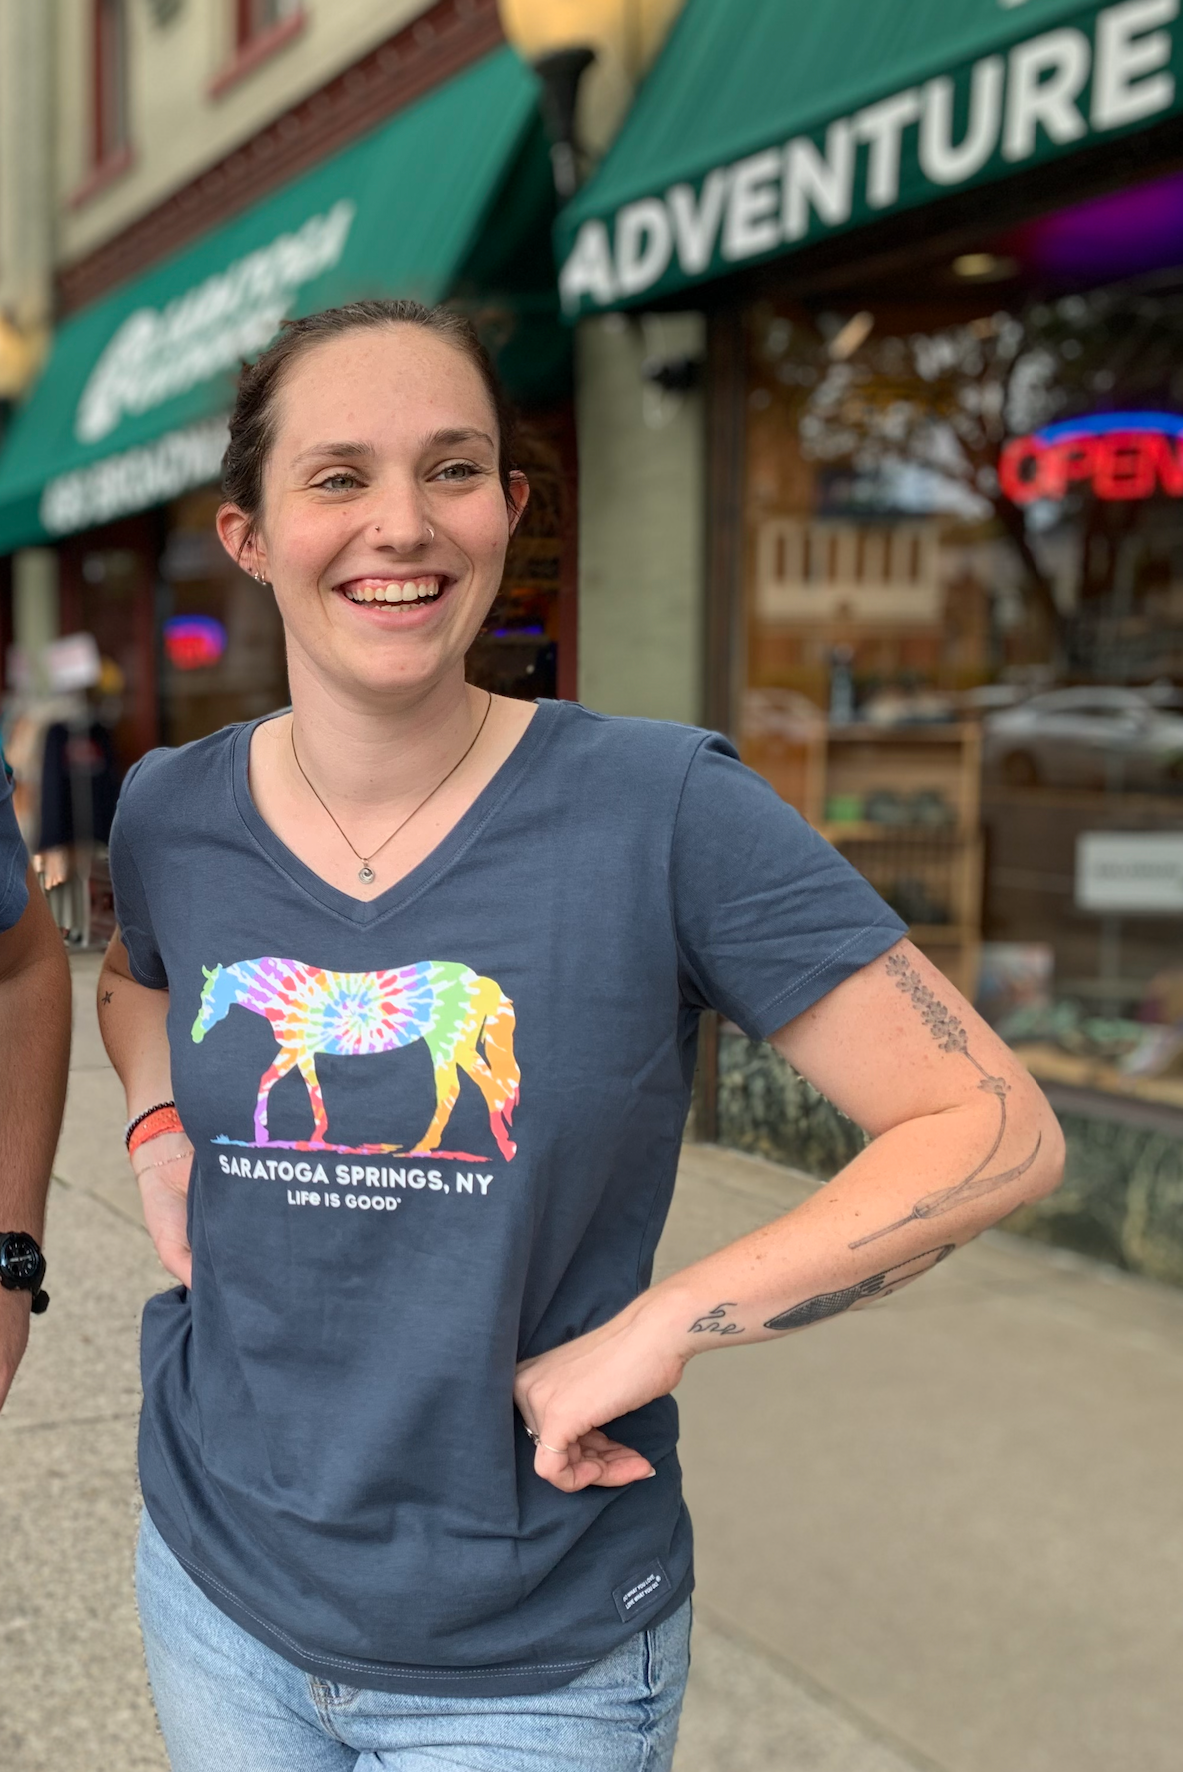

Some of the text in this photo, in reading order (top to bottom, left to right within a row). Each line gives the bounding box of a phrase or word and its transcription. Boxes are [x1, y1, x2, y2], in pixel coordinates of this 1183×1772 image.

[558, 0, 1179, 315] ADVENTURE
[218, 1154, 494, 1197] SARATOGA SPRINGS, NY
[324, 1191, 341, 1208] IS
